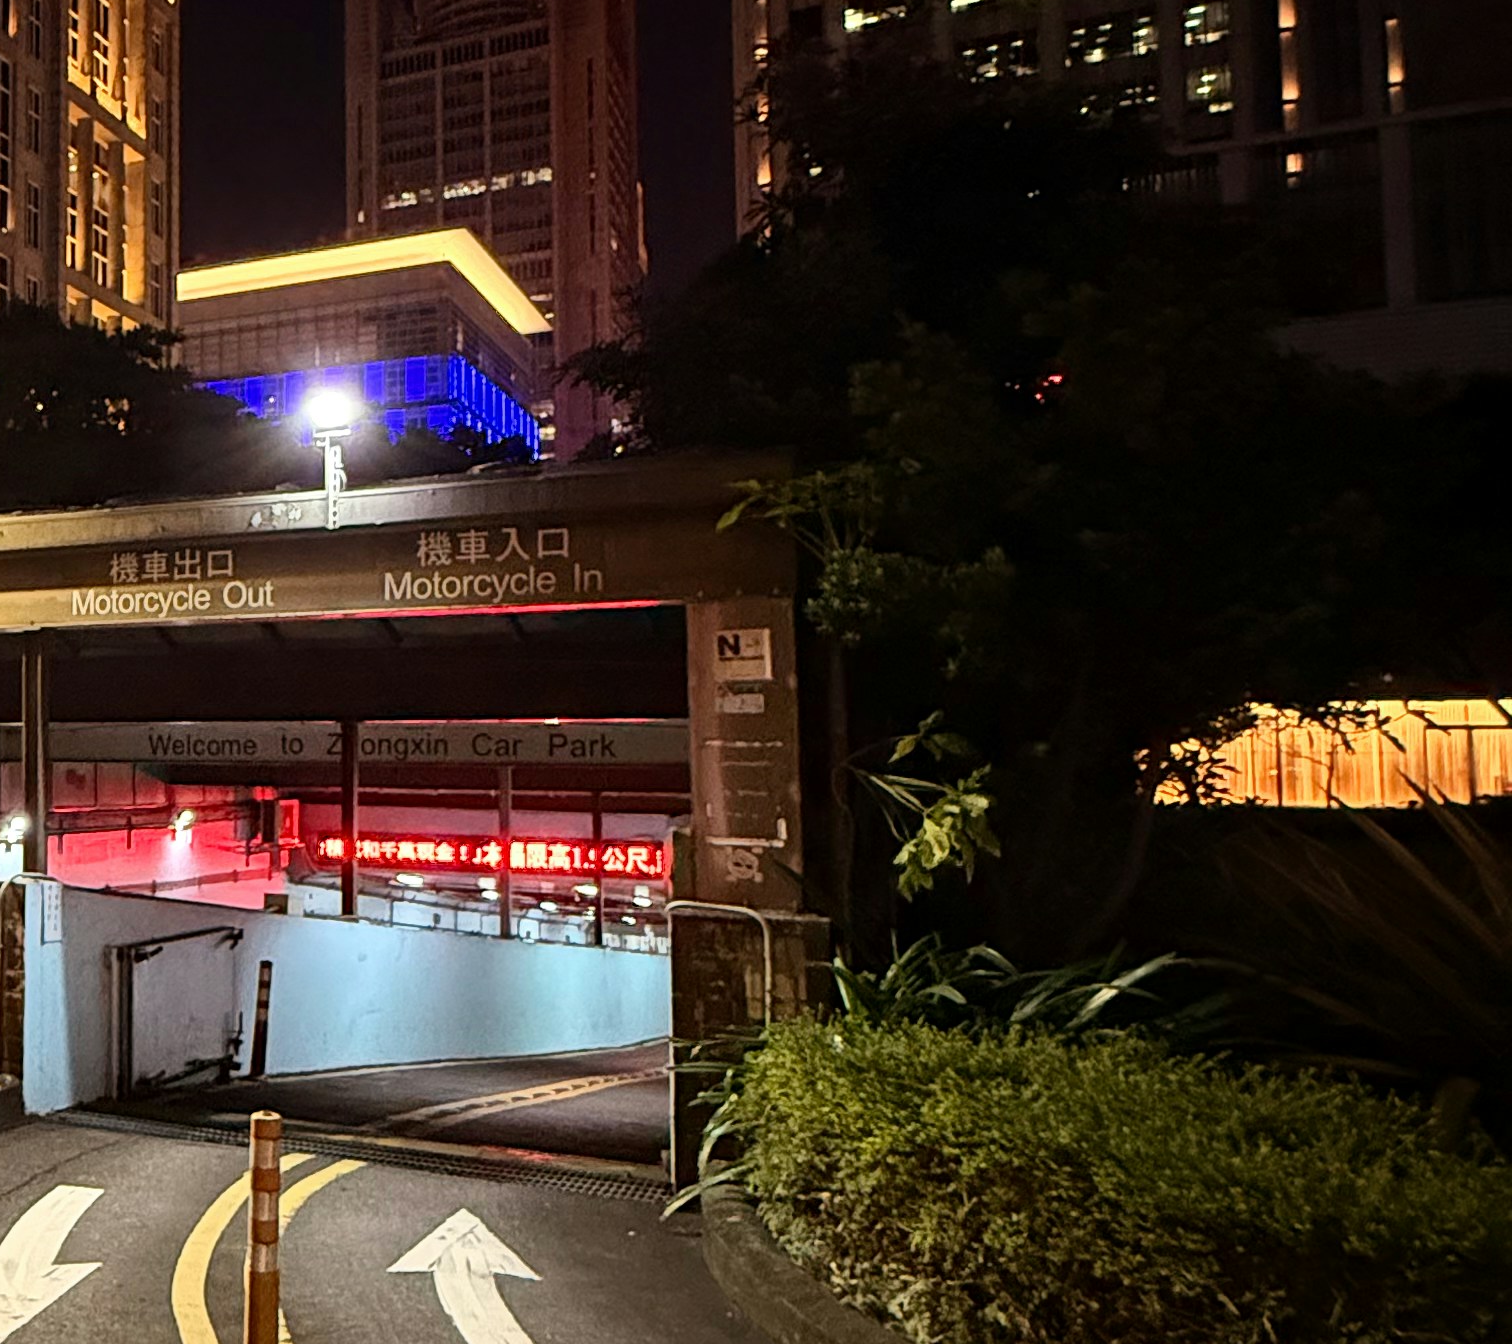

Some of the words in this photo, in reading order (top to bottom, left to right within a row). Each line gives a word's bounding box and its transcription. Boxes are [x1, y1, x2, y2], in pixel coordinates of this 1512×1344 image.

[417, 527, 570, 567] 機車入口
[110, 549, 234, 584] 機車出口
[384, 567, 557, 603] Motorcycle
[574, 564, 604, 593] In
[71, 584, 210, 617] Motorcycle
[223, 581, 274, 610] Out
[148, 733, 257, 757] Welcome
[281, 734, 303, 756] to
[326, 733, 448, 761] Zongxin
[472, 733, 522, 757] Car
[548, 733, 615, 758] Park
